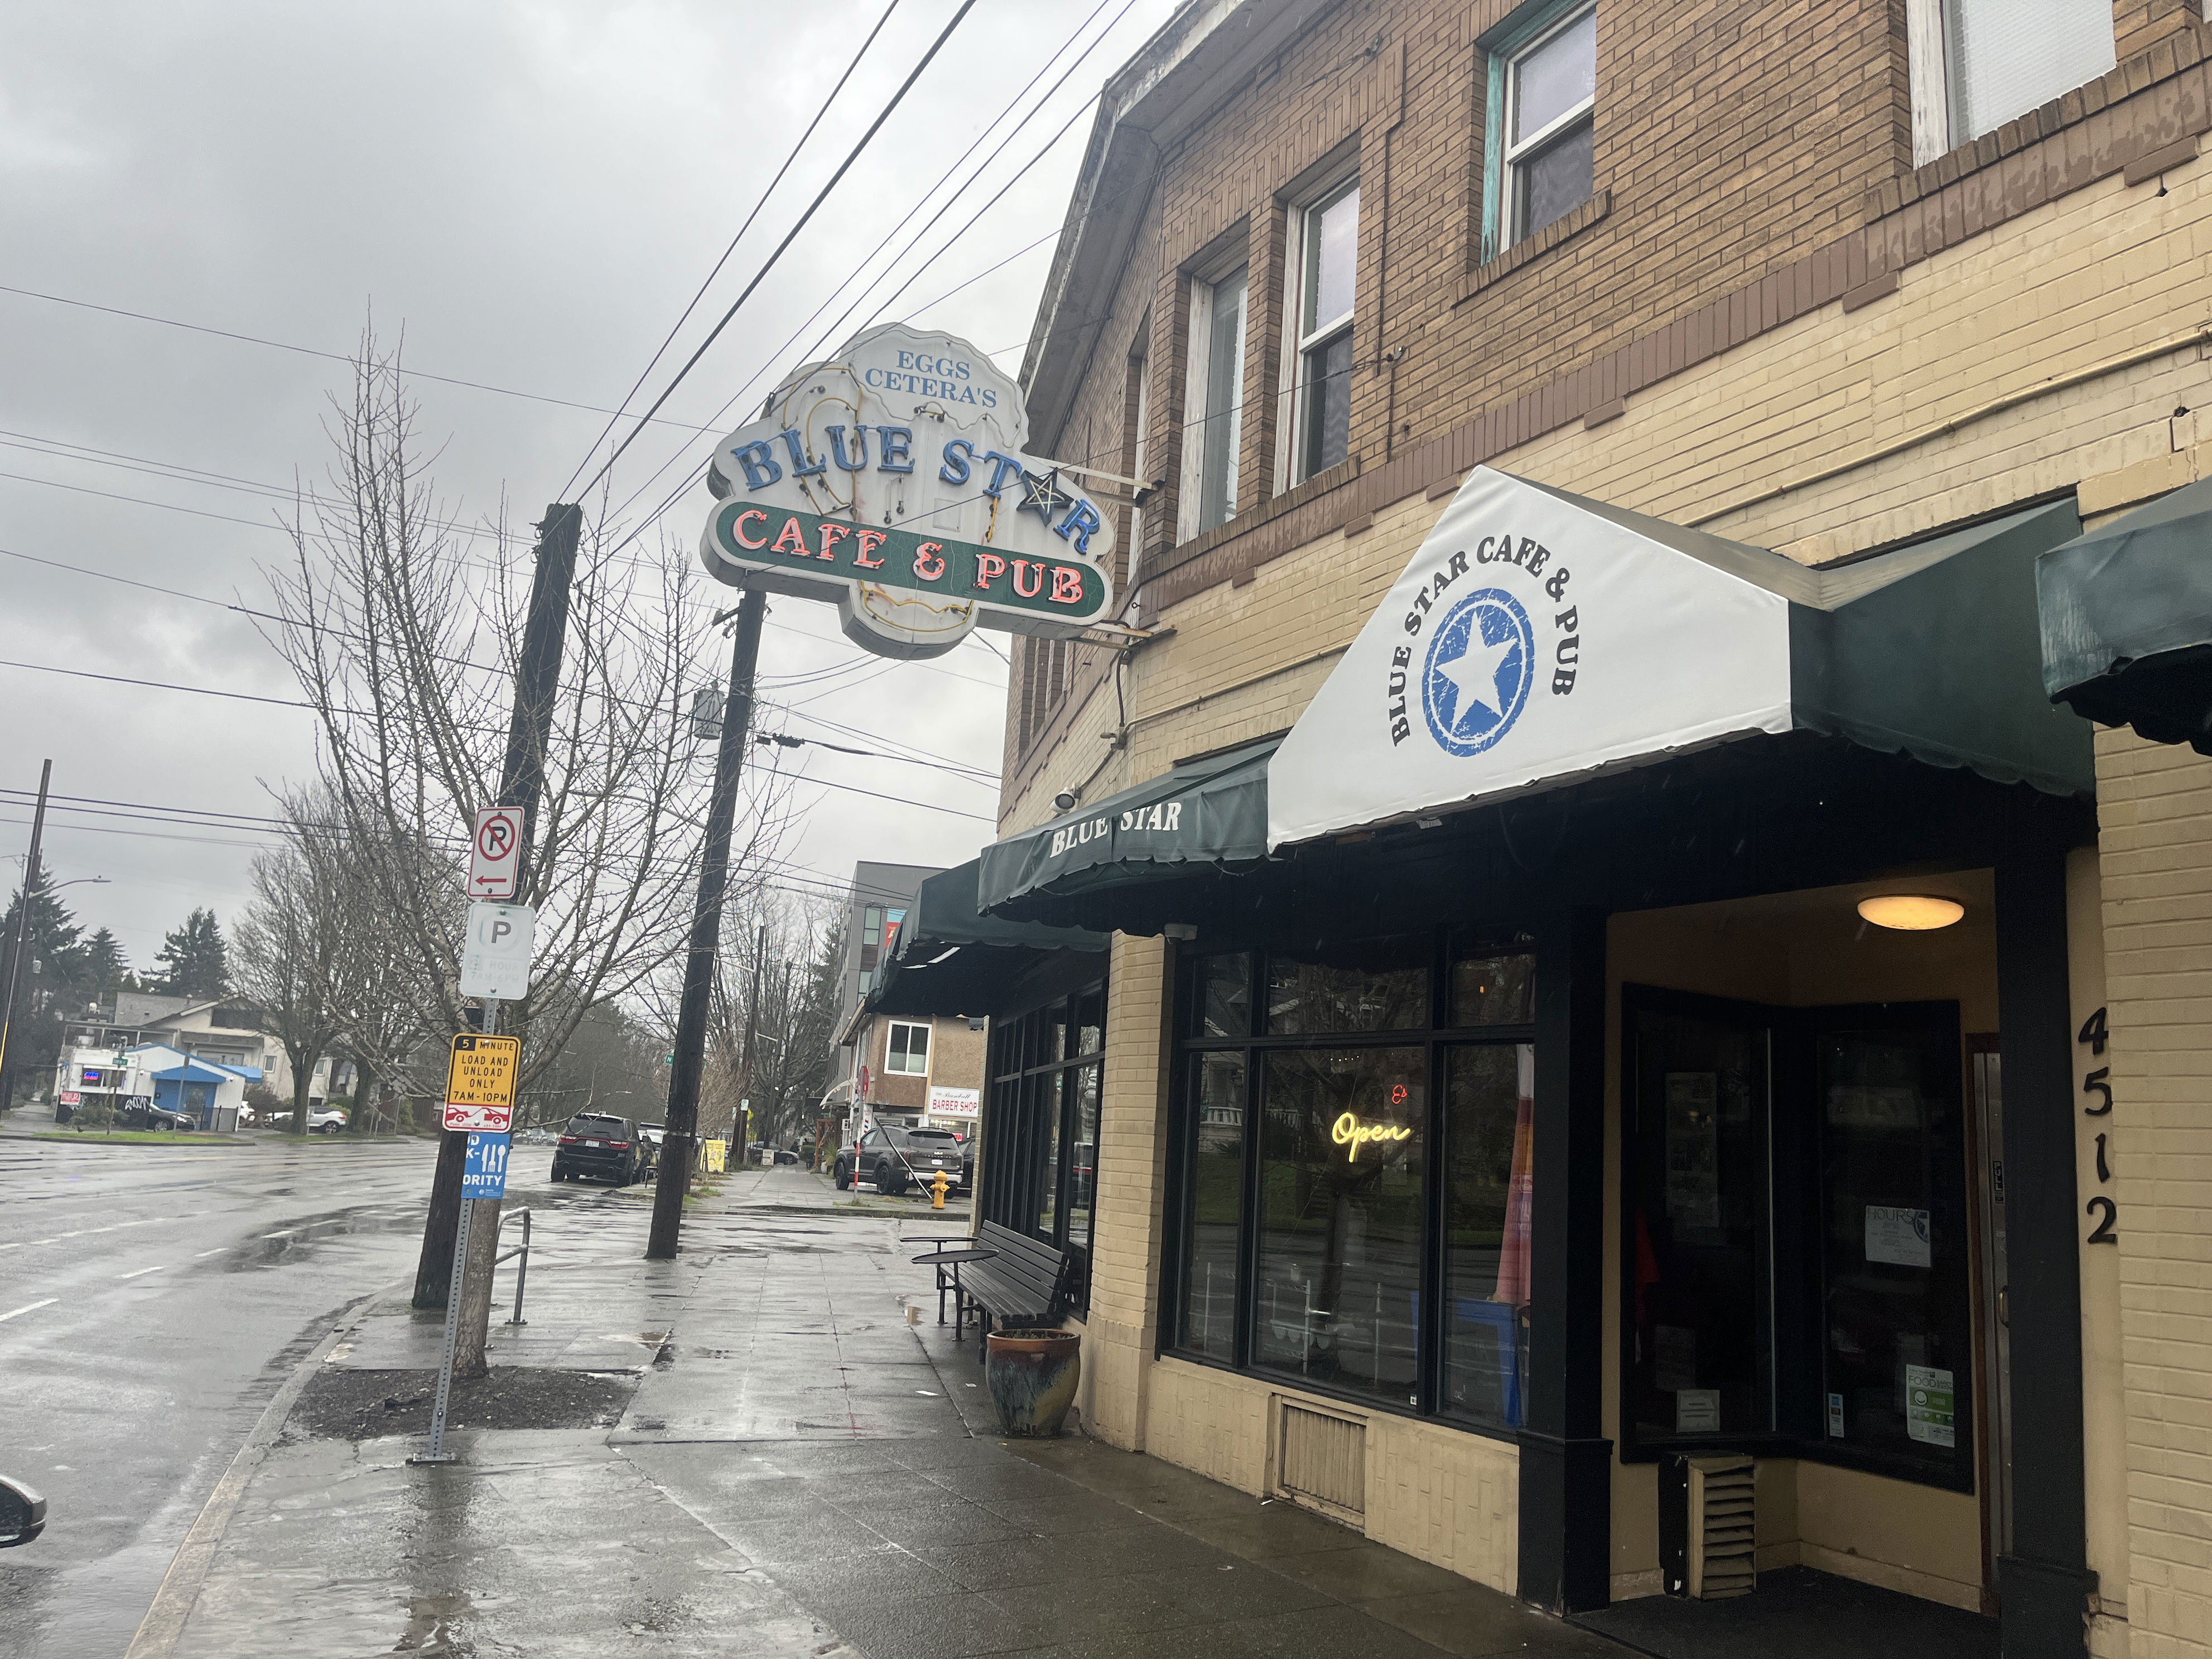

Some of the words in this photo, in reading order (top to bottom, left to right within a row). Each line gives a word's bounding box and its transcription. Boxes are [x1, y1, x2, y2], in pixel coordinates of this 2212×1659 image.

[896, 349, 971, 380] EGGS
[865, 368, 997, 408] CETERA'S
[730, 424, 915, 491] BLUE
[732, 509, 888, 570] CAFE
[913, 541, 946, 582] &
[972, 553, 1083, 604] PUB
[1476, 534, 1551, 578] CAFE
[1404, 551, 1470, 637] STAR
[1545, 567, 1570, 603] &
[1551, 604, 1579, 696] PUB
[1388, 645, 1412, 747] BLUE
[489, 826, 507, 851] P
[1049, 817, 1109, 859] BLUE
[1120, 802, 1182, 831] STAR
[491, 920, 512, 944] P
[461, 1054, 486, 1064] LOAD
[490, 1057, 508, 1067] AND
[462, 1039, 470, 1049] 5
[464, 1066, 503, 1077] UNLOAD
[470, 1078, 495, 1088] ONLY
[933, 1099, 958, 1111] BARBER
[961, 1102, 977, 1112] SHOP
[1332, 1111, 1411, 1163] Open
[462, 1174, 503, 1186] ORITY
[1909, 1375, 1936, 1388] FOOD
